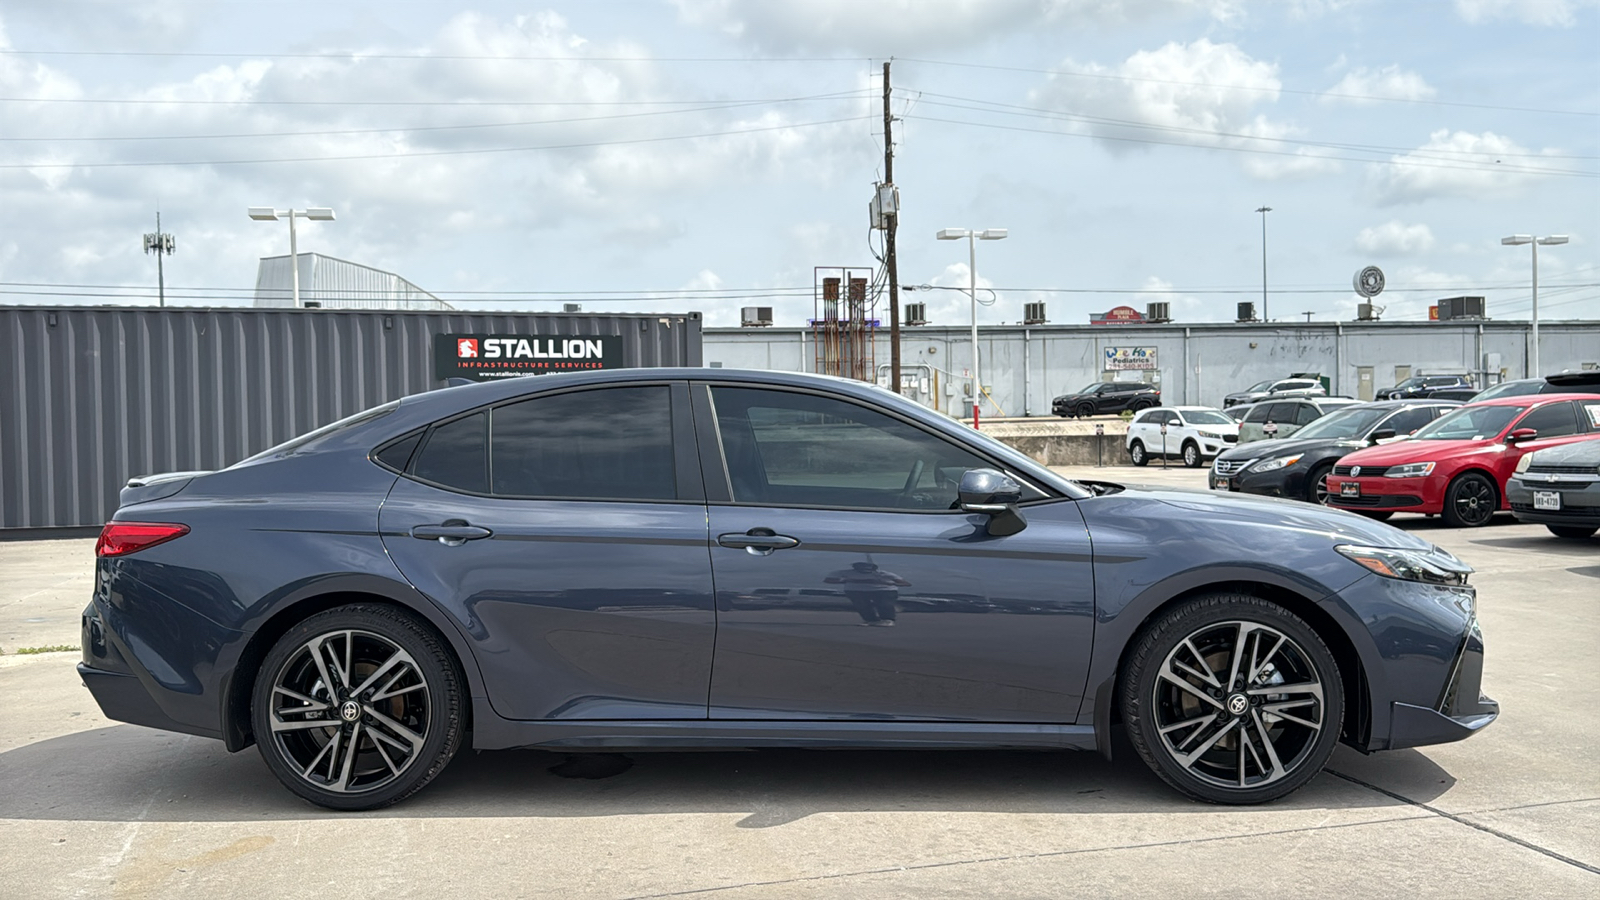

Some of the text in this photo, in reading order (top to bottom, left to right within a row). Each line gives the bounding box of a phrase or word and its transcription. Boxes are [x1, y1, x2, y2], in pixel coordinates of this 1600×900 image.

[483, 339, 603, 358] STALLION
[1106, 346, 1129, 358] Wee
[457, 361, 603, 369] INFRASTRUCTURE SERVICES
